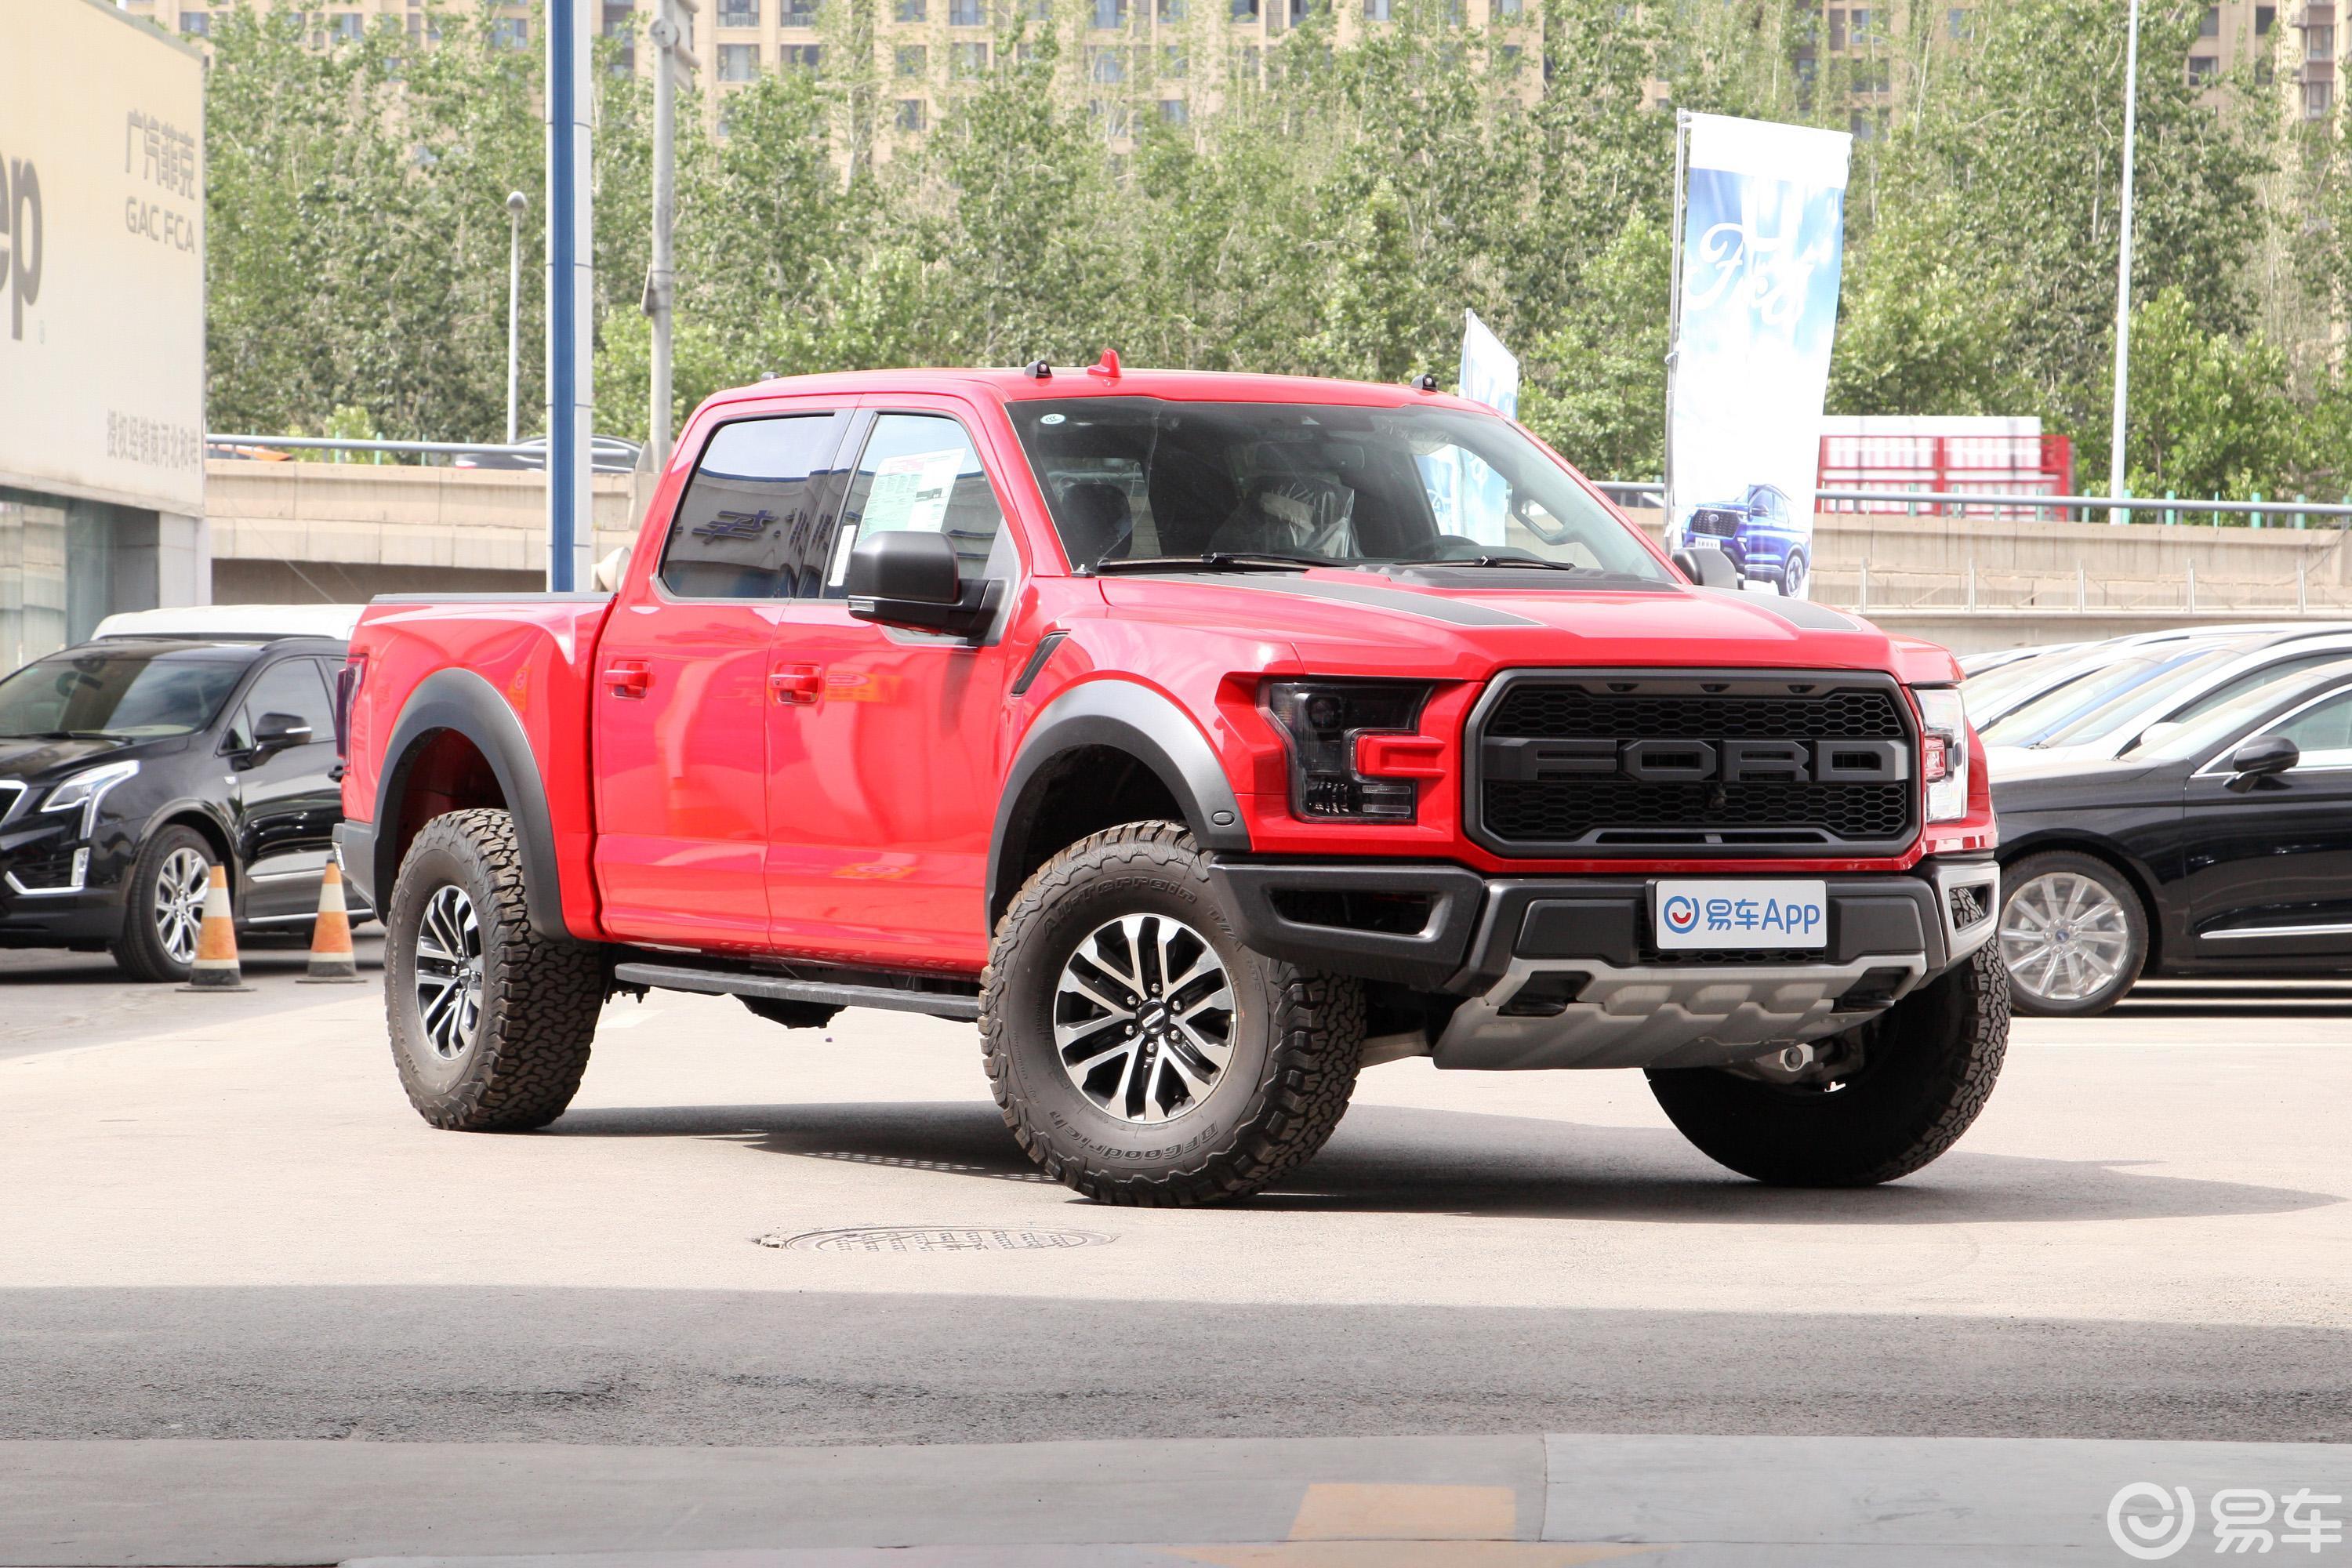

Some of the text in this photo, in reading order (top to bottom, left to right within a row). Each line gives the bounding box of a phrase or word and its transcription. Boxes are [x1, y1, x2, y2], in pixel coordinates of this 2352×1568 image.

[125, 108, 195, 201] 广汽菲克
[125, 195, 195, 254] GAC FCA
[1499, 739, 1905, 782] FORD
[1044, 876, 1197, 935] All-Terrain
[1705, 898, 1820, 935] 易车App
[1049, 1110, 1218, 1161] BFGoodrich
